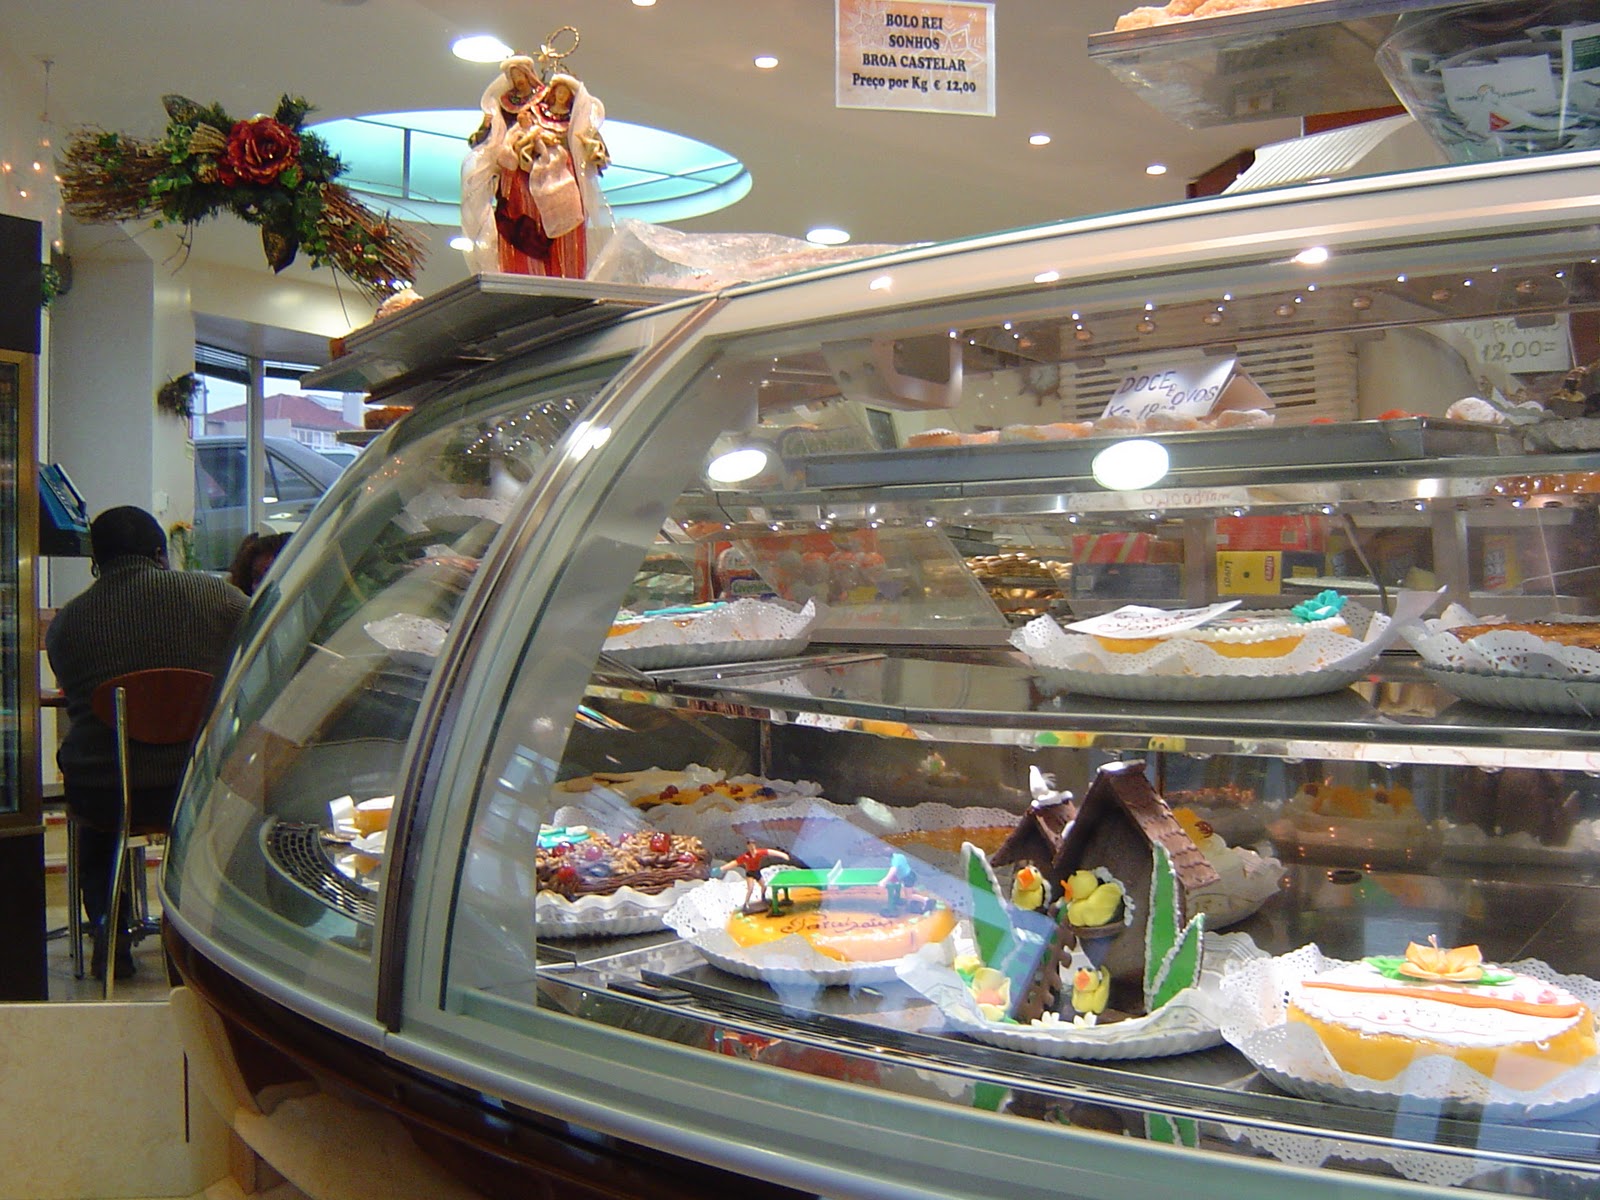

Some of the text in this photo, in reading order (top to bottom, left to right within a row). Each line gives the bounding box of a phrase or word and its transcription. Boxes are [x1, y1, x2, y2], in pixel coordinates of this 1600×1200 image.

[885, 13, 943, 30] BOLO REI
[888, 34, 940, 50] SONHOS
[862, 53, 967, 72] BROA CASTELAR
[852, 73, 977, 94] Preço por Kg € 12,00
[1117, 370, 1176, 395] DOCE
[1170, 385, 1218, 406] OVOS
